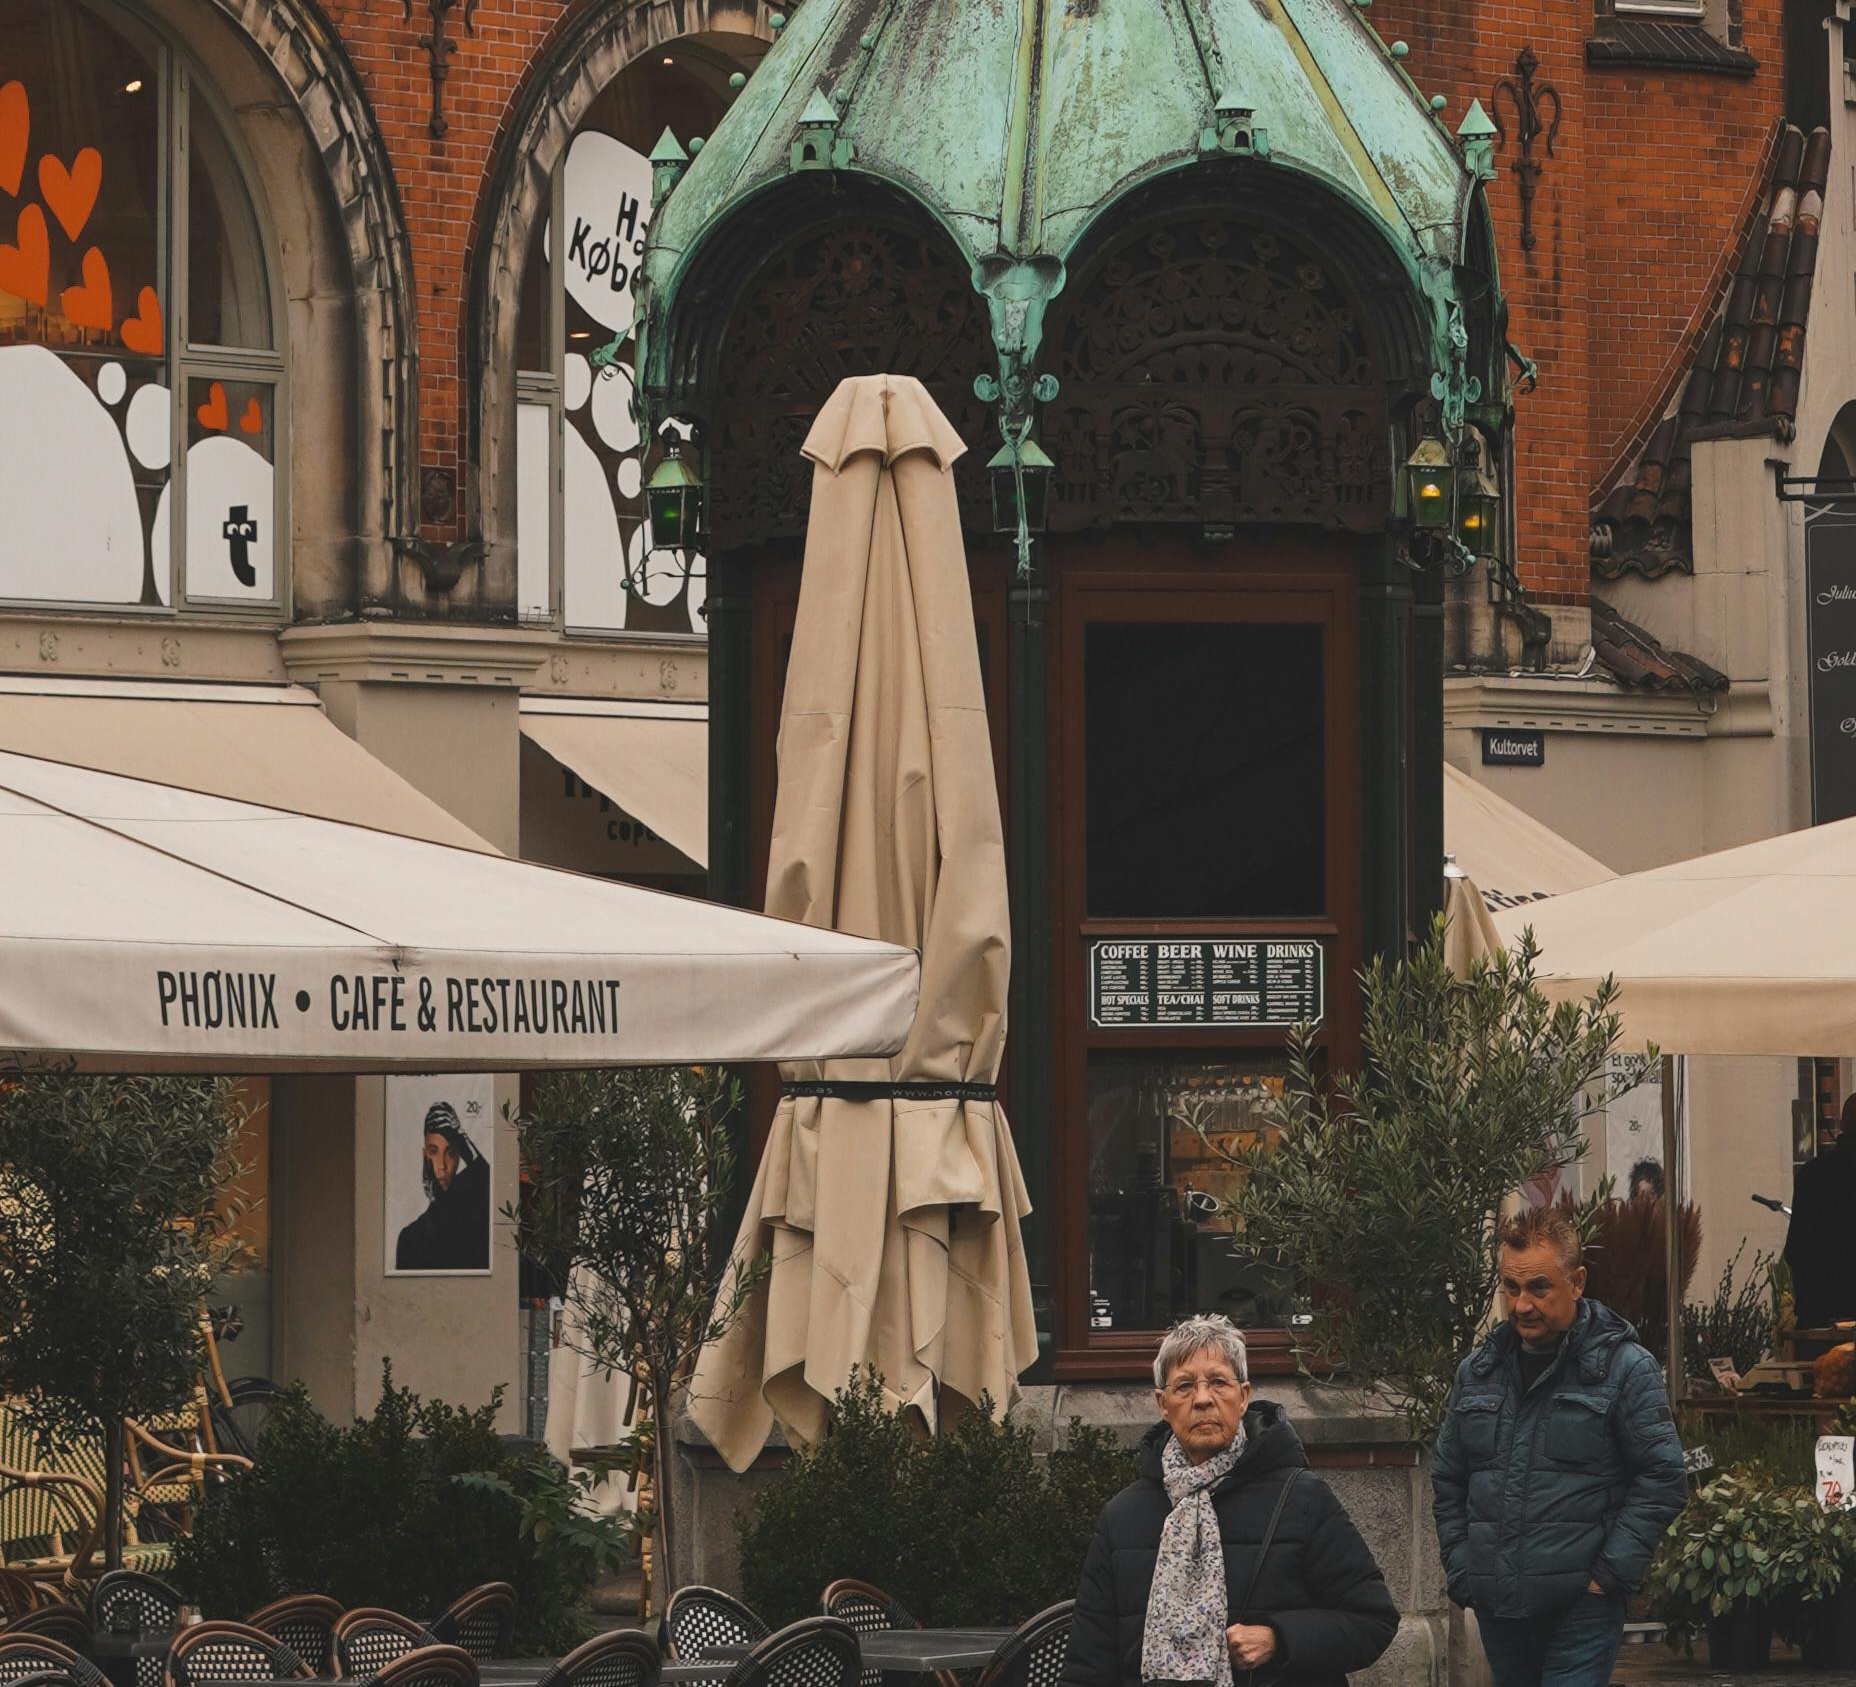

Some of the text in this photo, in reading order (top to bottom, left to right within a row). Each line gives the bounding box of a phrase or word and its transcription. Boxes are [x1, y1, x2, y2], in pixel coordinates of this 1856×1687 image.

[1489, 737, 1538, 756] Kultorvet
[1101, 945, 1149, 959] COFFEE
[1157, 945, 1202, 959] BEER
[1213, 944, 1258, 958] WINE
[1266, 944, 1314, 958] DRINKS
[157, 970, 279, 1030] PHØNIX
[418, 976, 436, 1032] &
[447, 978, 620, 1034] RESTAURANT
[1101, 995, 1149, 1005] HOT SPECIALS
[1157, 994, 1204, 1005] TEA/CHAI
[1213, 994, 1260, 1005] SOFT DRINKS
